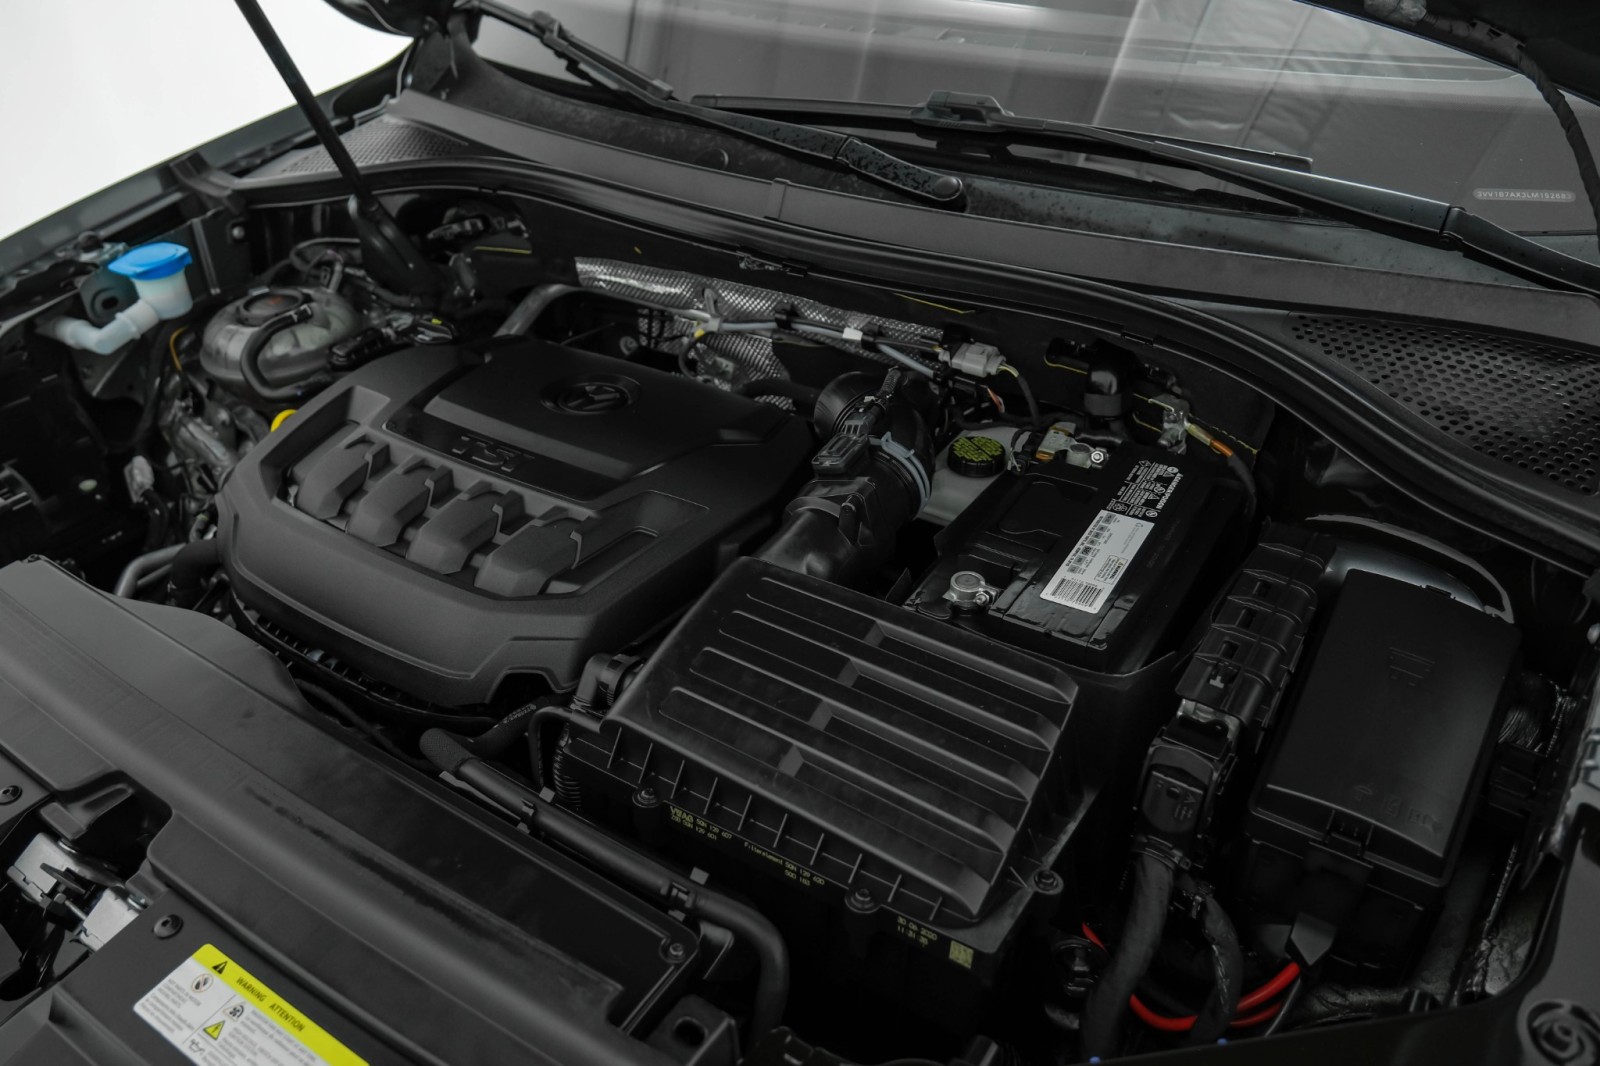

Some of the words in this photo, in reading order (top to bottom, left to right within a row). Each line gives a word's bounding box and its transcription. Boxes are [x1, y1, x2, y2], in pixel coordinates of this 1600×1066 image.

[452, 433, 535, 473] TSI
[236, 976, 267, 1002] WARNING
[269, 1002, 306, 1032] ATTENTION
